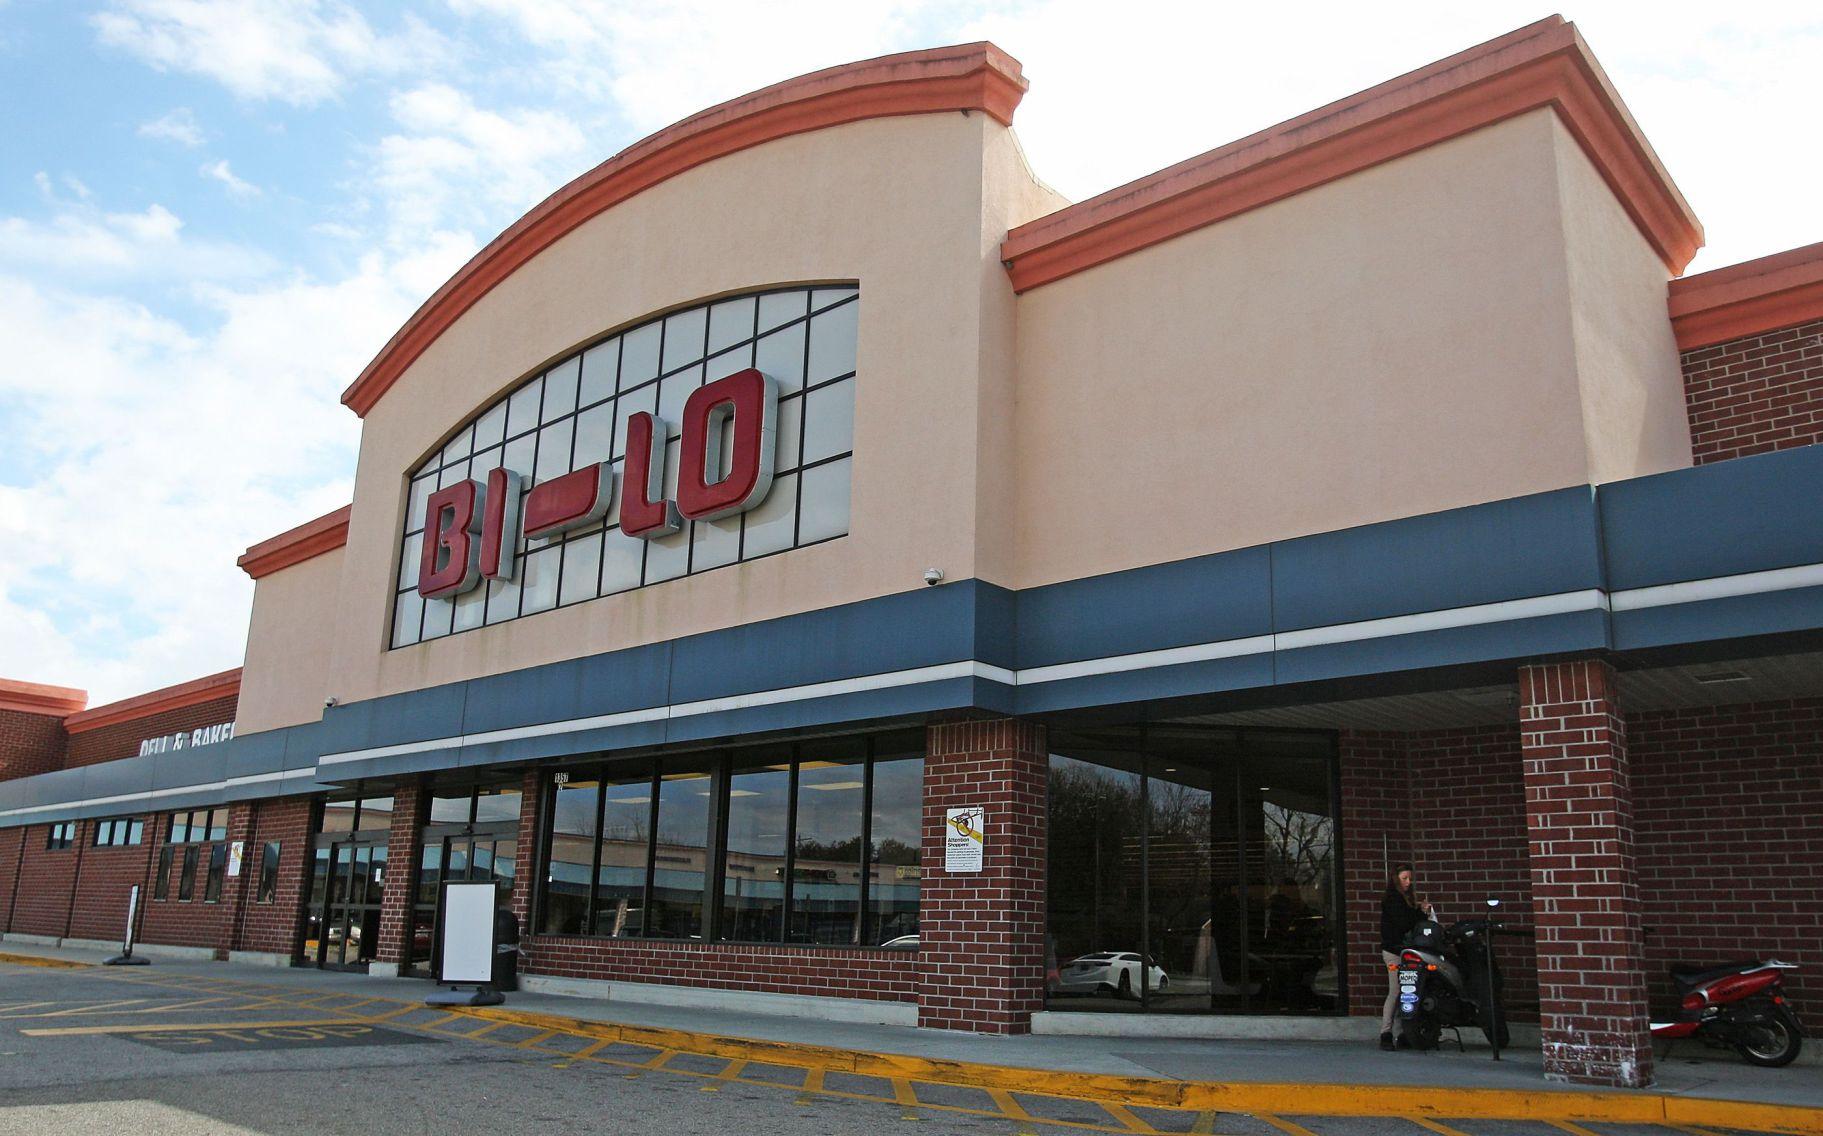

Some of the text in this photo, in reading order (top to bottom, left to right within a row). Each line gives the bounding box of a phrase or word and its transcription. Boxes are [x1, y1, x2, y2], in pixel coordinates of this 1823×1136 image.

[418, 367, 778, 599] BI-LO
[191, 722, 236, 748] BAKE
[133, 1025, 374, 1045] STOP
